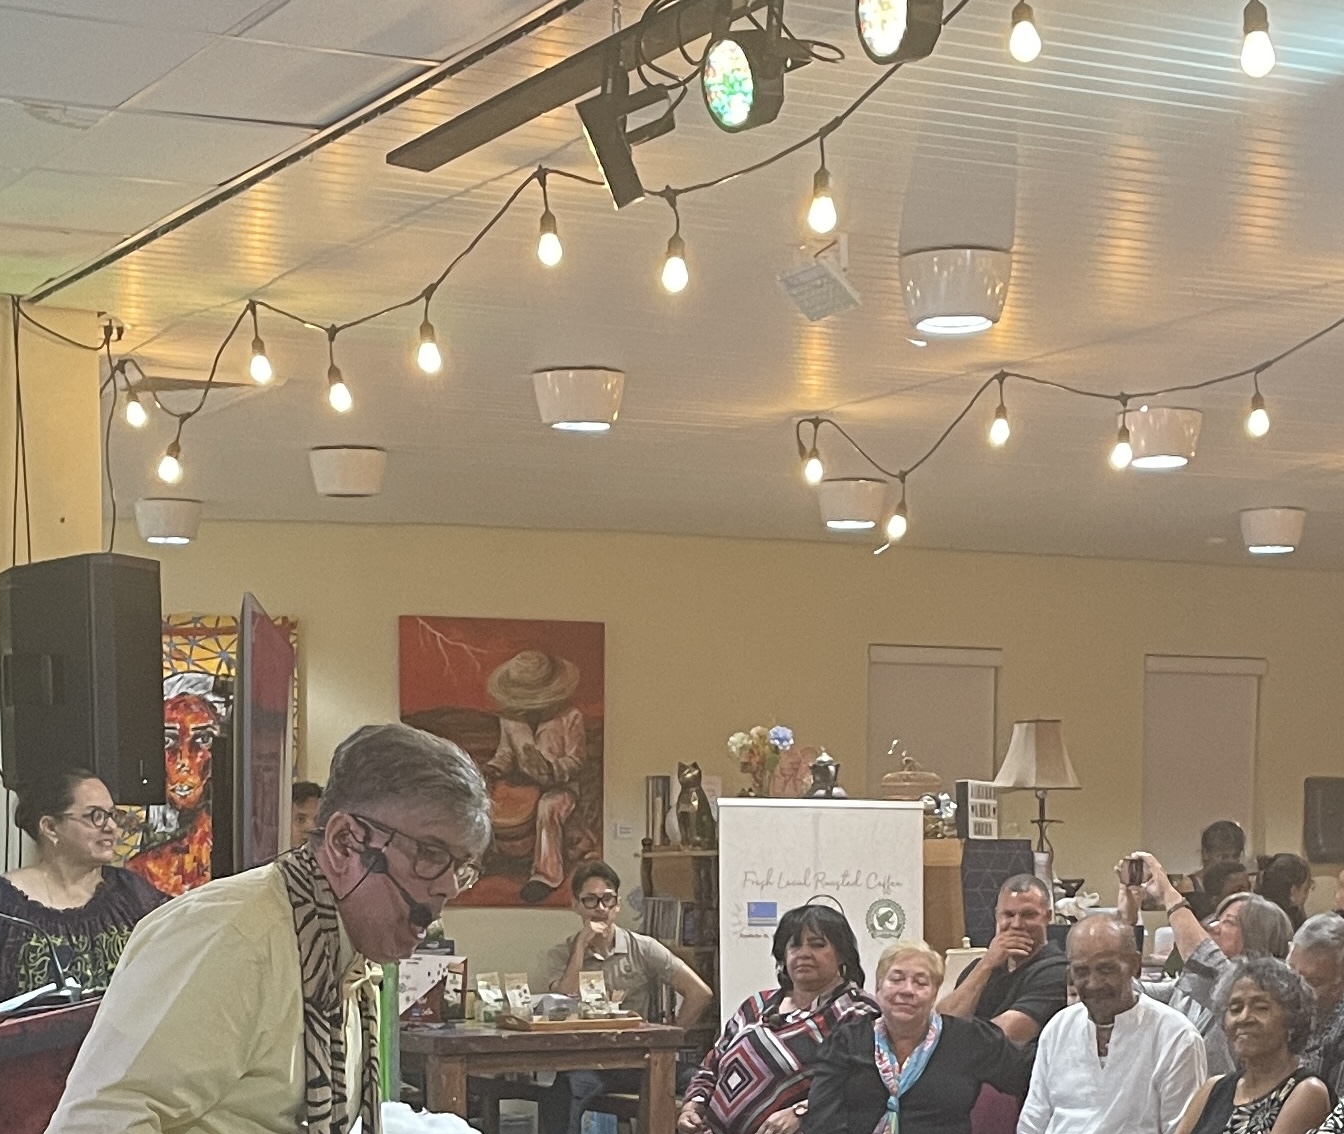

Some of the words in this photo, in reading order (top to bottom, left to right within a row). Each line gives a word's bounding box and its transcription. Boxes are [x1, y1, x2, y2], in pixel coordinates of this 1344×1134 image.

[742, 867, 775, 890] Fresh
[777, 866, 811, 889] Local
[813, 869, 862, 891] Roasted
[865, 871, 903, 895] Coffee
